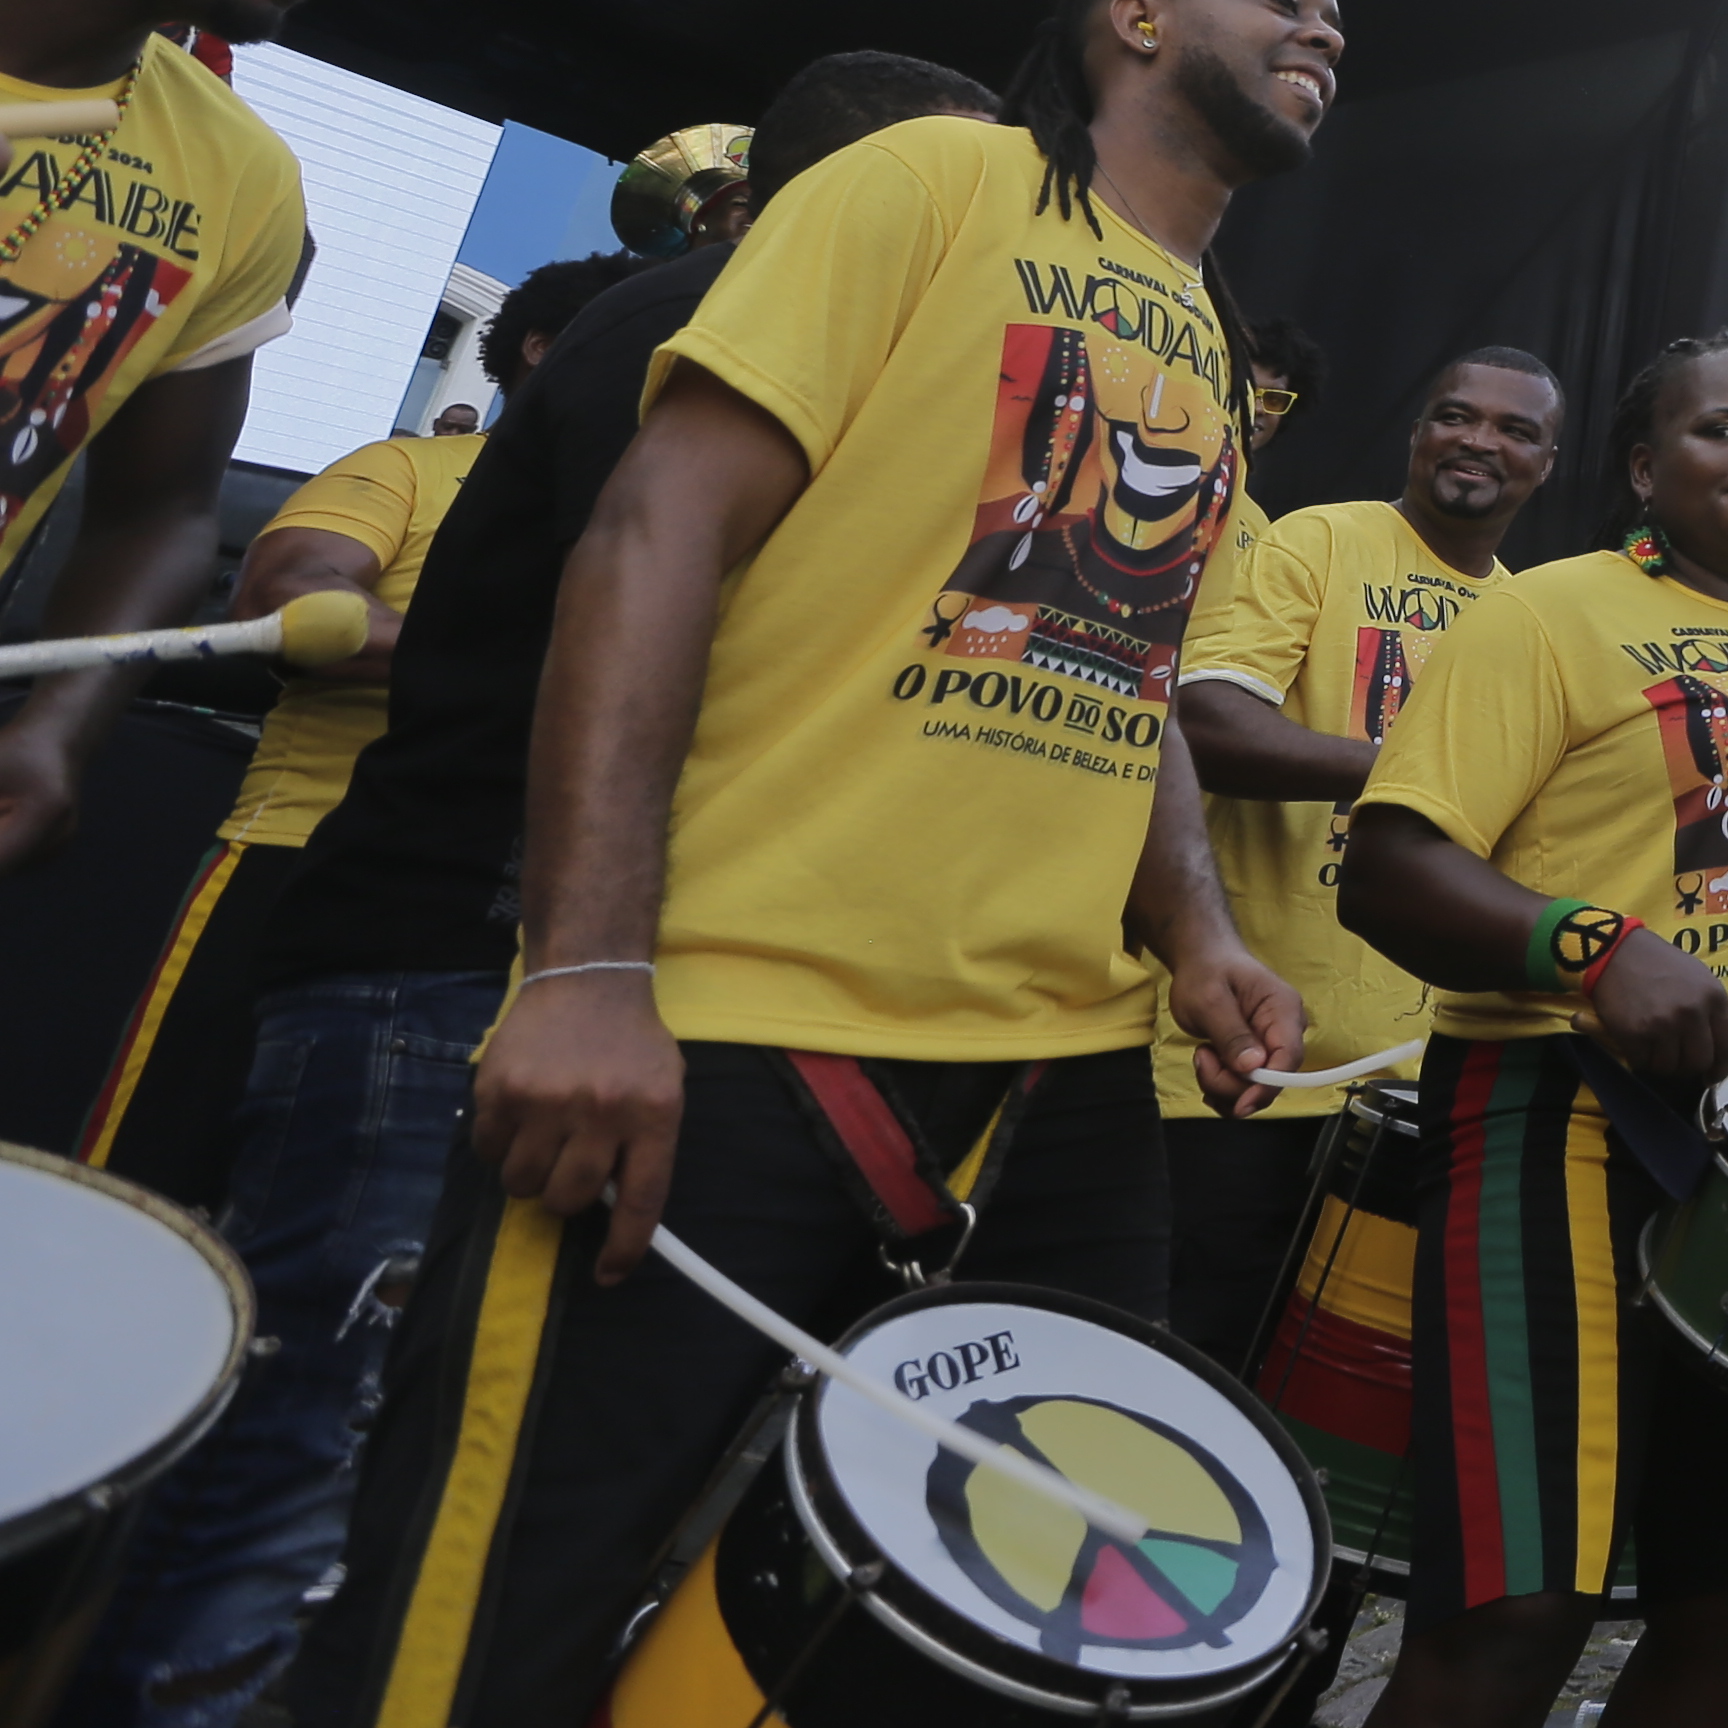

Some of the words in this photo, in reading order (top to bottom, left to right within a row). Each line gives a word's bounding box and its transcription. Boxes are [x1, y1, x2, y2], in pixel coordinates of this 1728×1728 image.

[107, 148, 153, 174] 2024
[1098, 257, 1169, 297] CARNAVAL
[1014, 258, 1222, 406] WODAA
[893, 663, 926, 700] O
[931, 669, 1063, 722] POVO
[1065, 695, 1102, 731] DO
[1101, 706, 1162, 748] SO
[923, 721, 971, 740] UMA
[975, 725, 1047, 757] HISTÓRIA
[1050, 743, 1071, 763] DE
[1072, 749, 1118, 777] BELEZA
[1122, 762, 1134, 779] E
[1318, 863, 1342, 887] O
[1673, 927, 1701, 955] O
[895, 1330, 1021, 1401] GOPE
